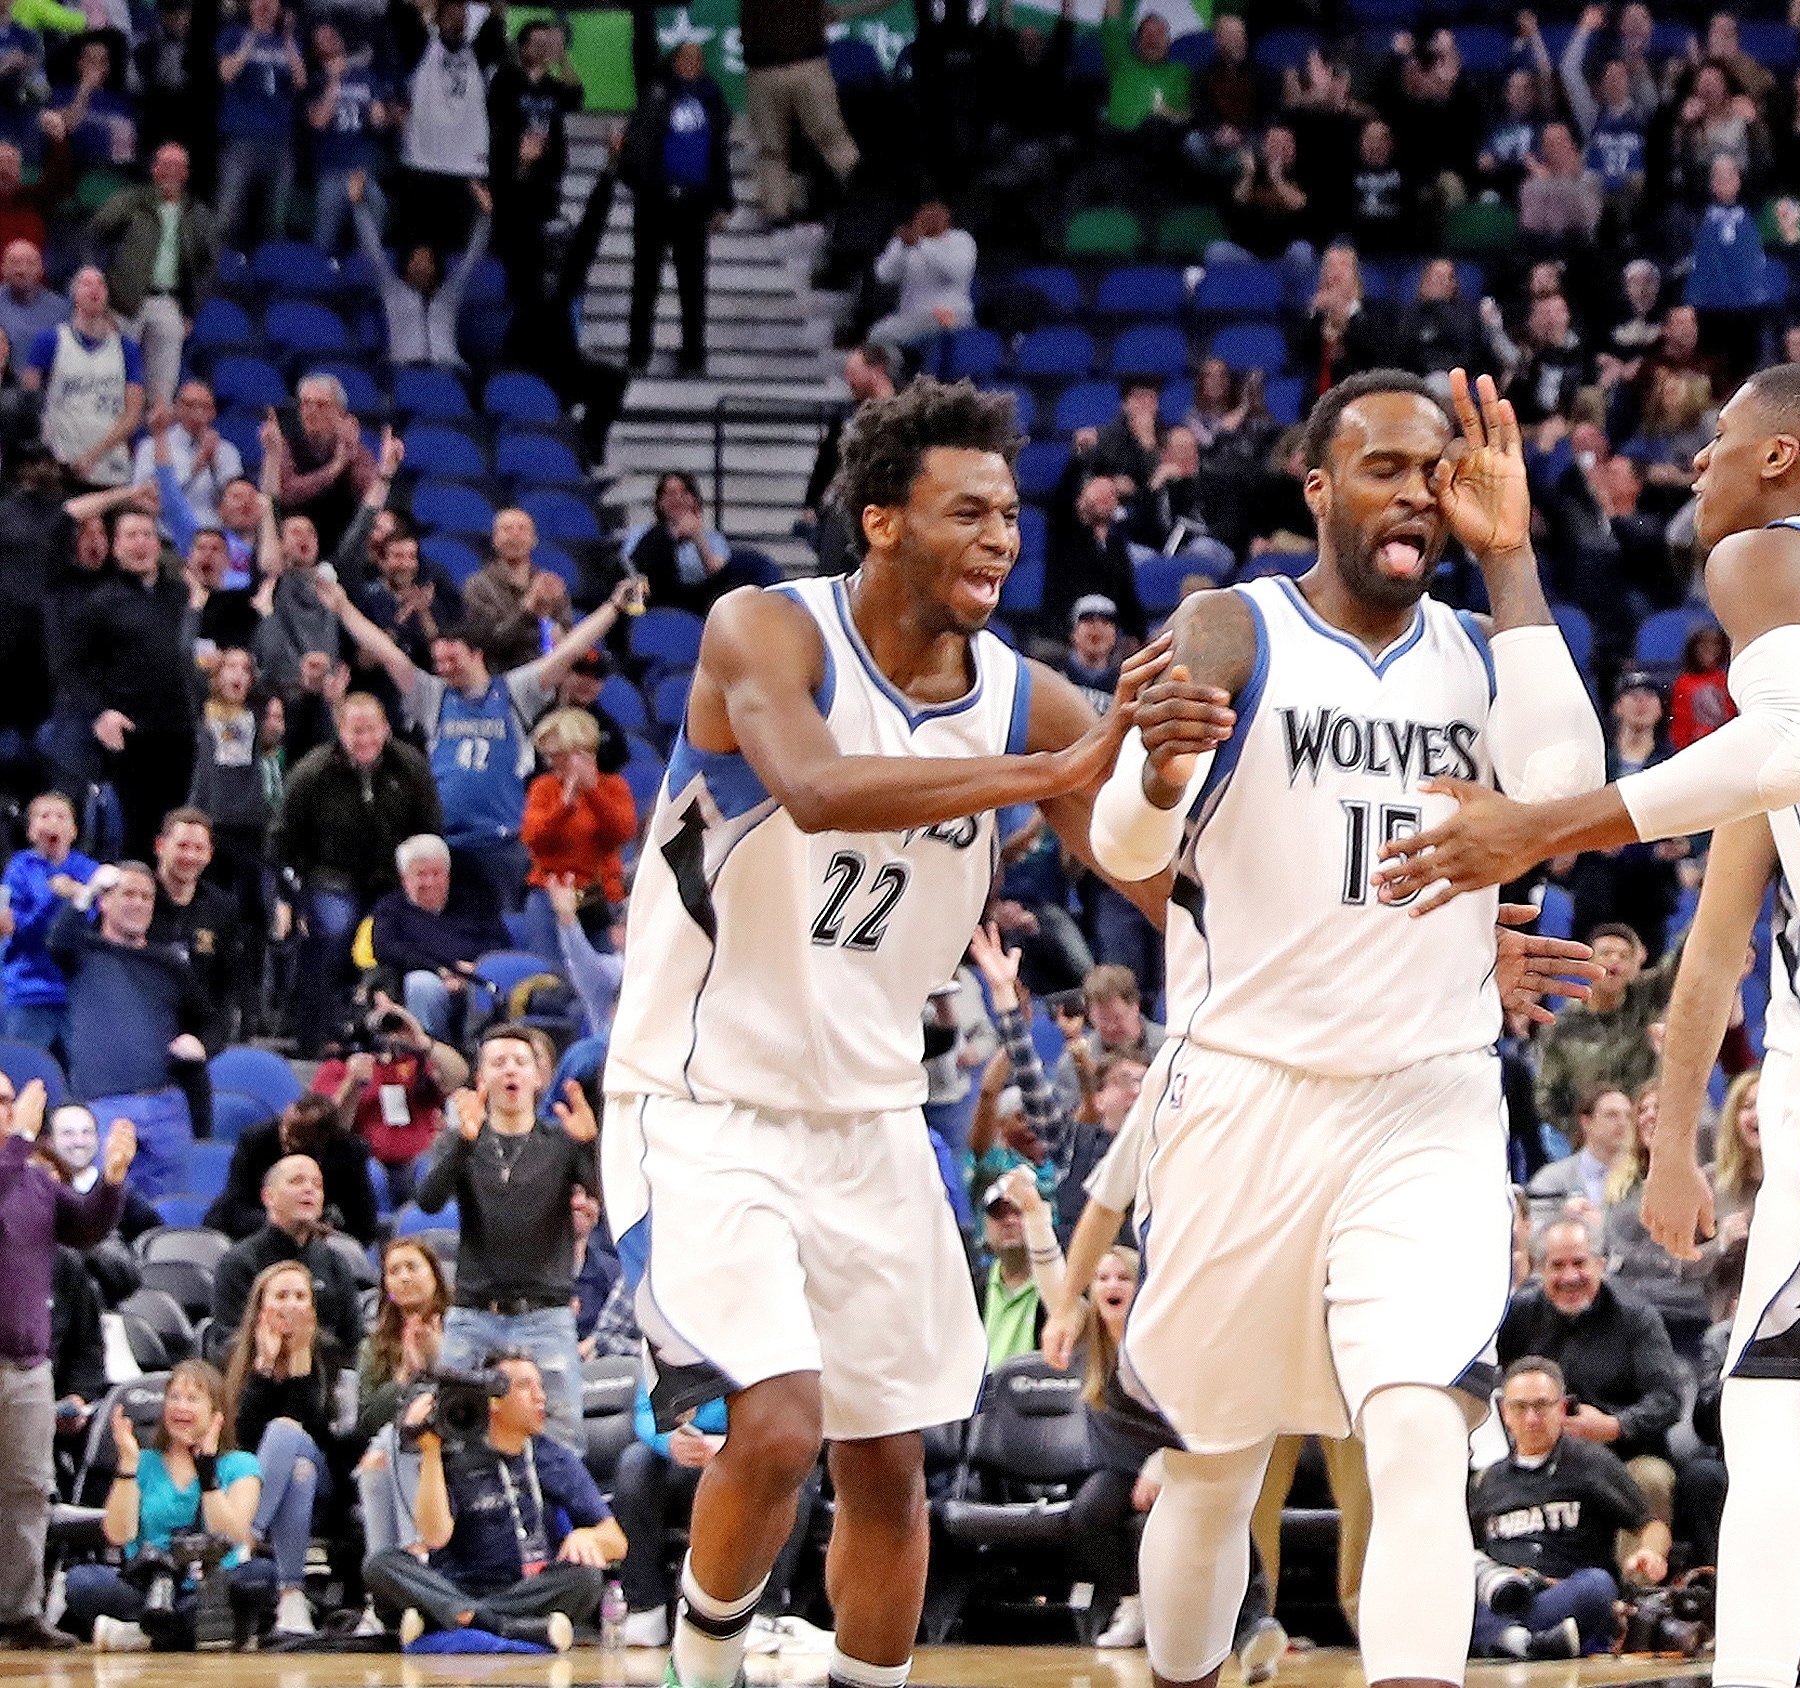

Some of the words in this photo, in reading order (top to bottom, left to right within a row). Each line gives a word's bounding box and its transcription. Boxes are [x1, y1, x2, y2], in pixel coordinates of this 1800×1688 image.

[1274, 704, 1480, 794] WOLVES
[810, 849, 912, 952] 22
[1544, 1501, 1581, 1530] TV
